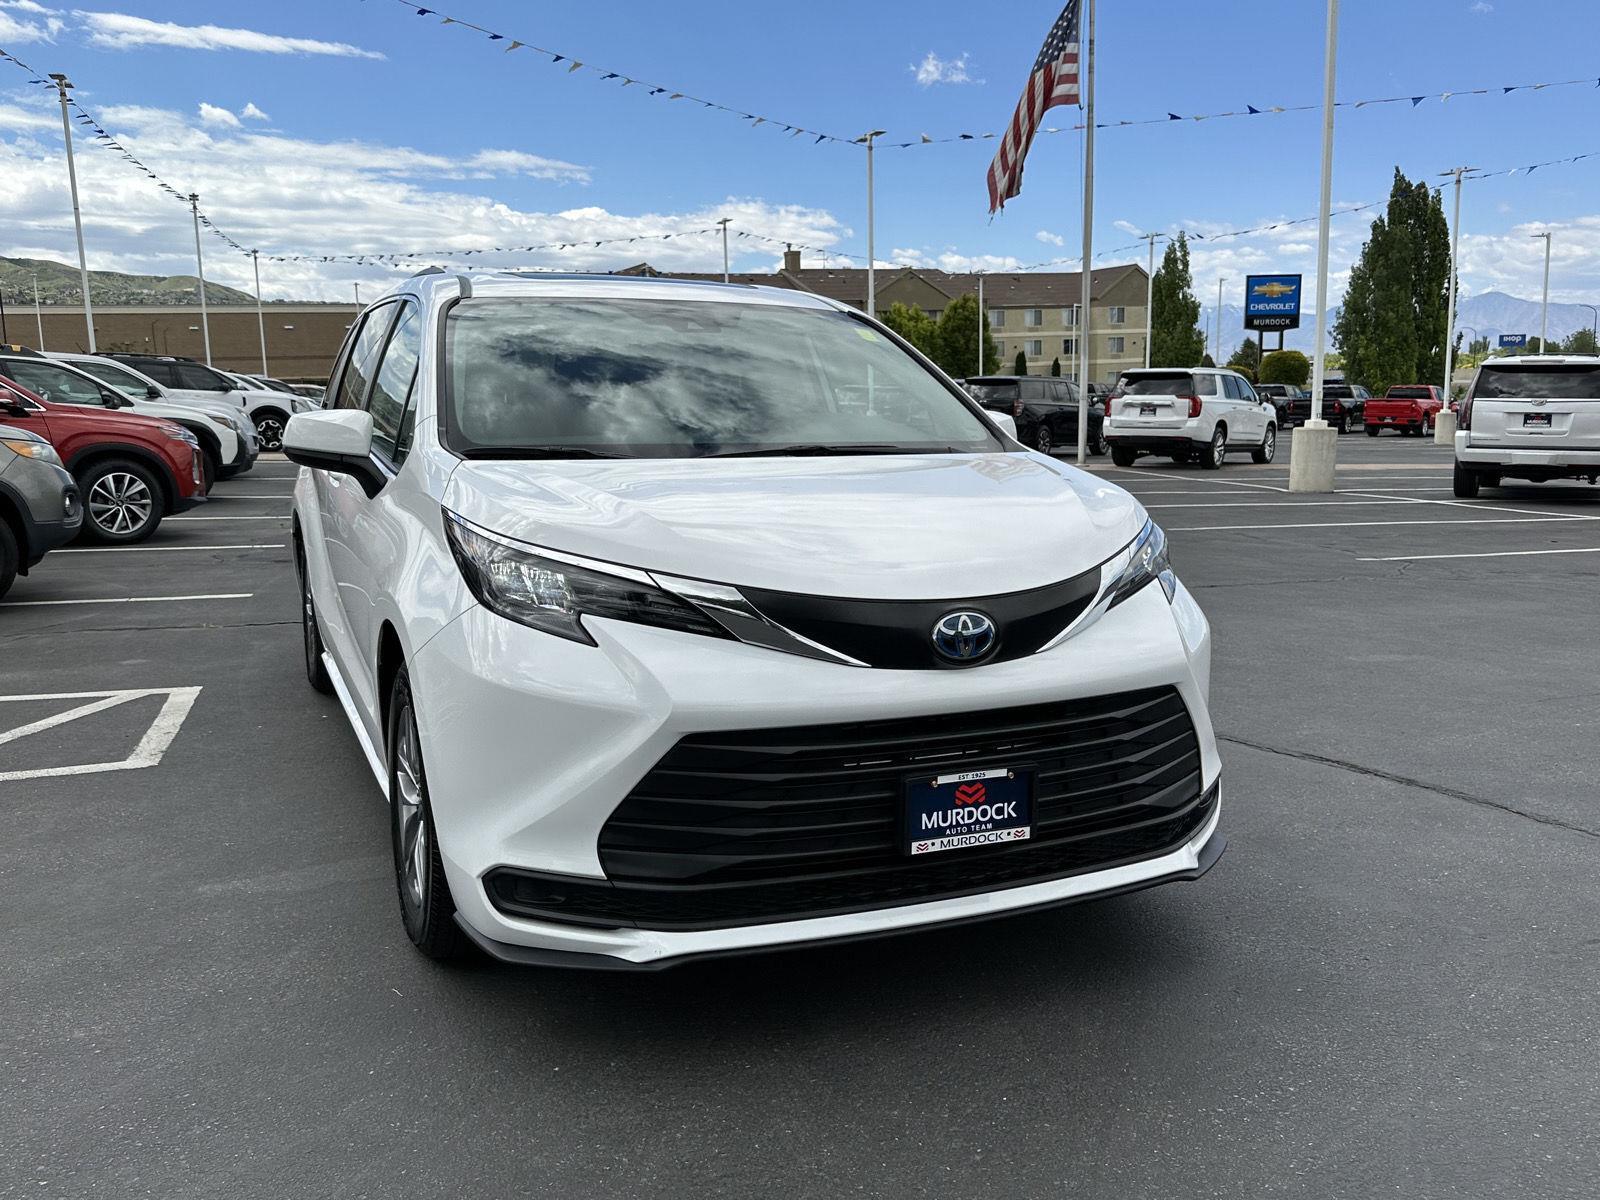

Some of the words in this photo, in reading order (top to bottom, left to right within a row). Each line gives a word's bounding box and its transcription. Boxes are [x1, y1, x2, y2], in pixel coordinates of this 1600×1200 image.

[922, 801, 1017, 830] MURDOCK
[945, 827, 967, 835] AUTO
[971, 823, 993, 831] TEAM
[940, 832, 1004, 848] MURDOCK
